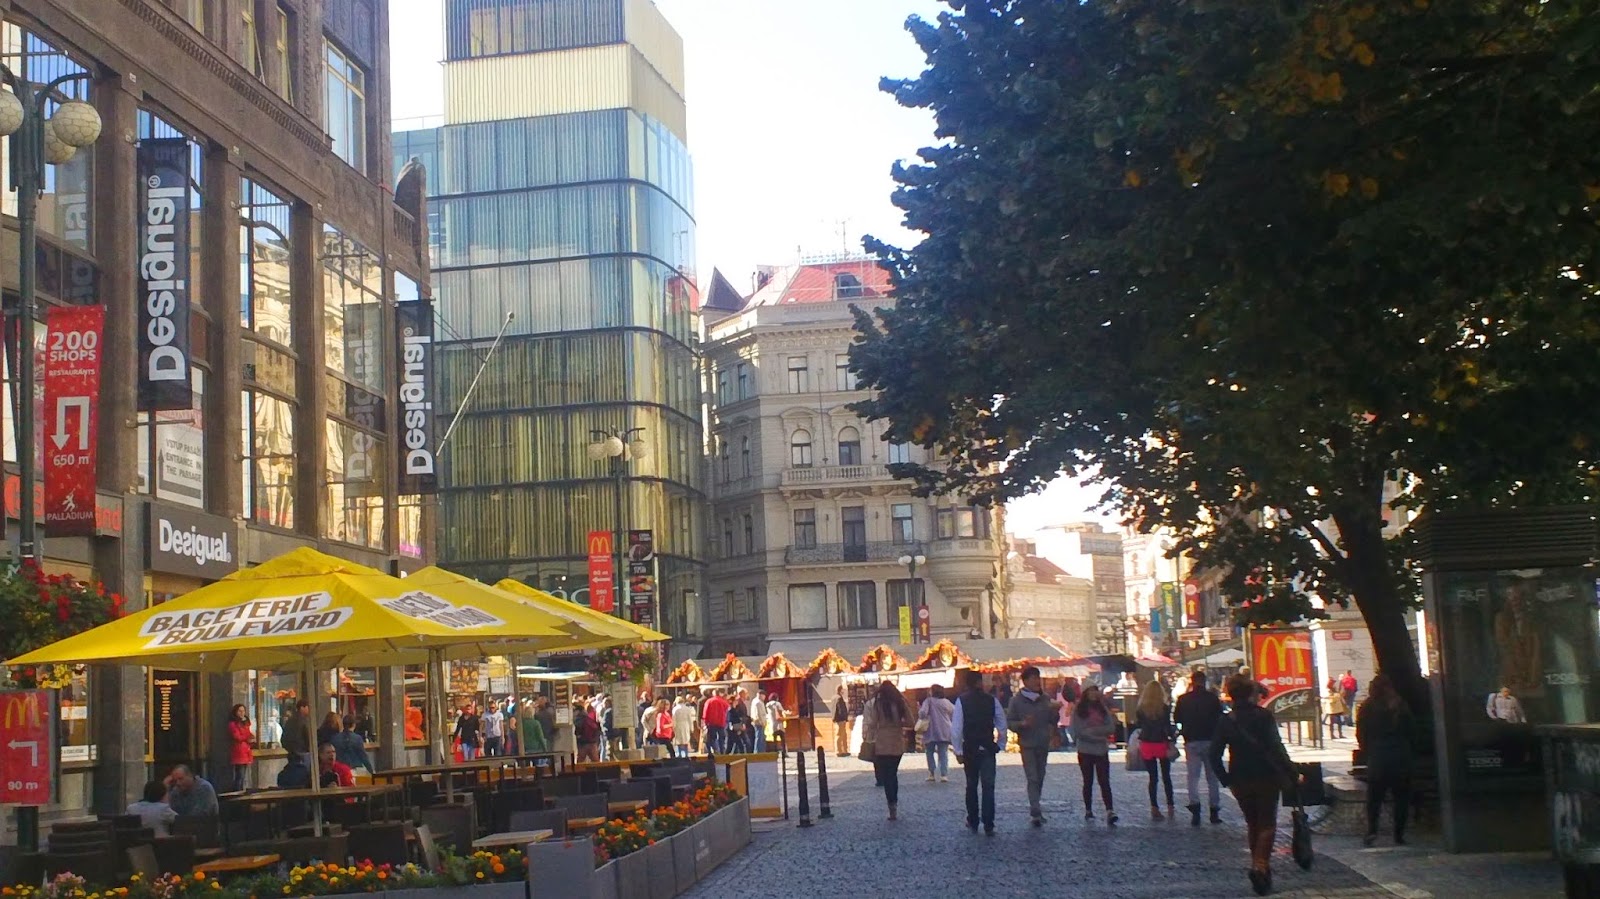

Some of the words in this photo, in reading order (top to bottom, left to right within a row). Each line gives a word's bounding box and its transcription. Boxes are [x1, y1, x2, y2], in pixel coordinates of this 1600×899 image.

[50, 330, 98, 350] 200
[49, 350, 97, 362] SHOPS
[49, 368, 96, 377] RESTAURANTS
[53, 454, 75, 466] 650
[78, 455, 90, 465] m
[166, 465, 177, 476] THE
[46, 511, 94, 521] PALLADIUM
[159, 518, 229, 565] Desigual
[147, 592, 324, 634] BAGETERIE
[158, 610, 343, 646] BOULEVARD
[1277, 676, 1293, 686] 90
[1294, 677, 1307, 685] m
[8, 781, 23, 791] 90
[25, 781, 39, 791] m
